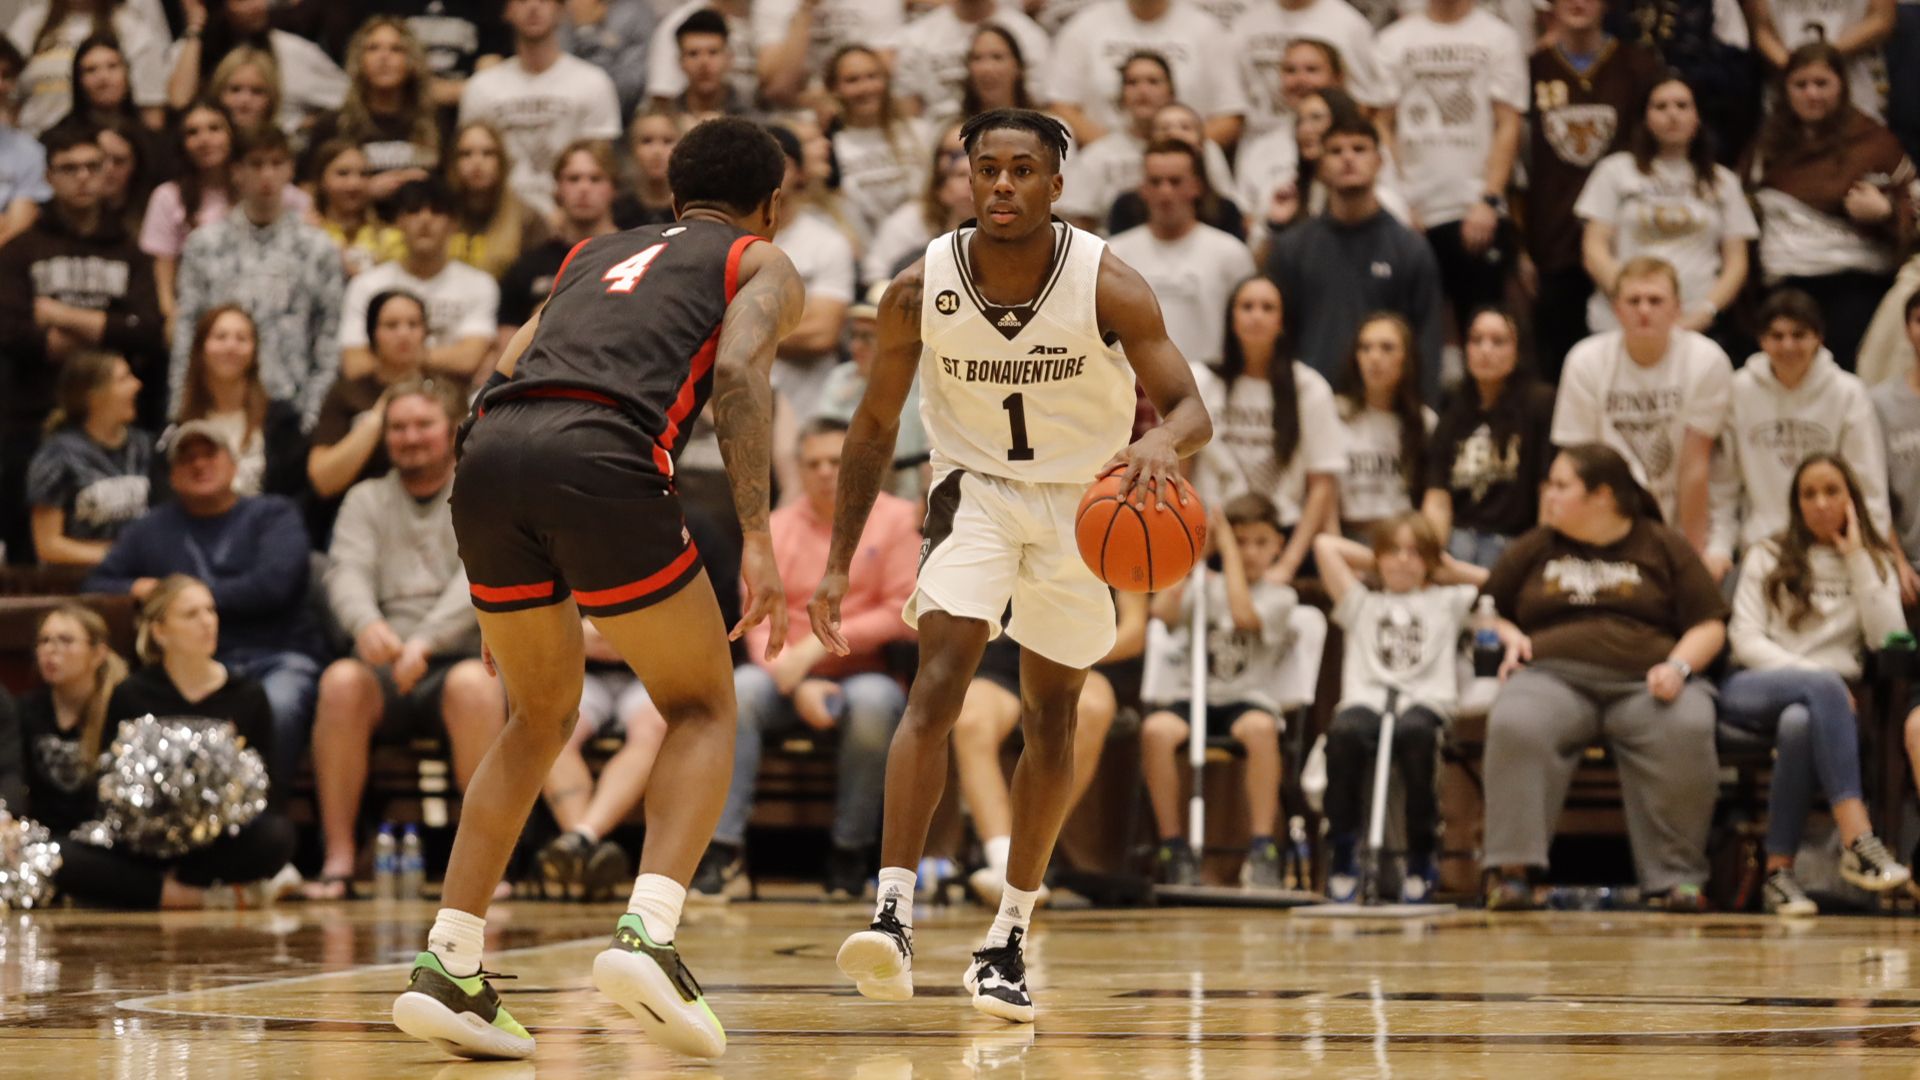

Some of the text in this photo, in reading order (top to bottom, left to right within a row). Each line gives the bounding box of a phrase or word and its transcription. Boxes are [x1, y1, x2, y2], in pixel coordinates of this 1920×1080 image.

[601, 242, 669, 294] 4
[938, 294, 957, 311] 31
[1027, 345, 1067, 355] A10
[940, 355, 1086, 385] ST. BONAVENTURE
[1002, 392, 1034, 461] 1
